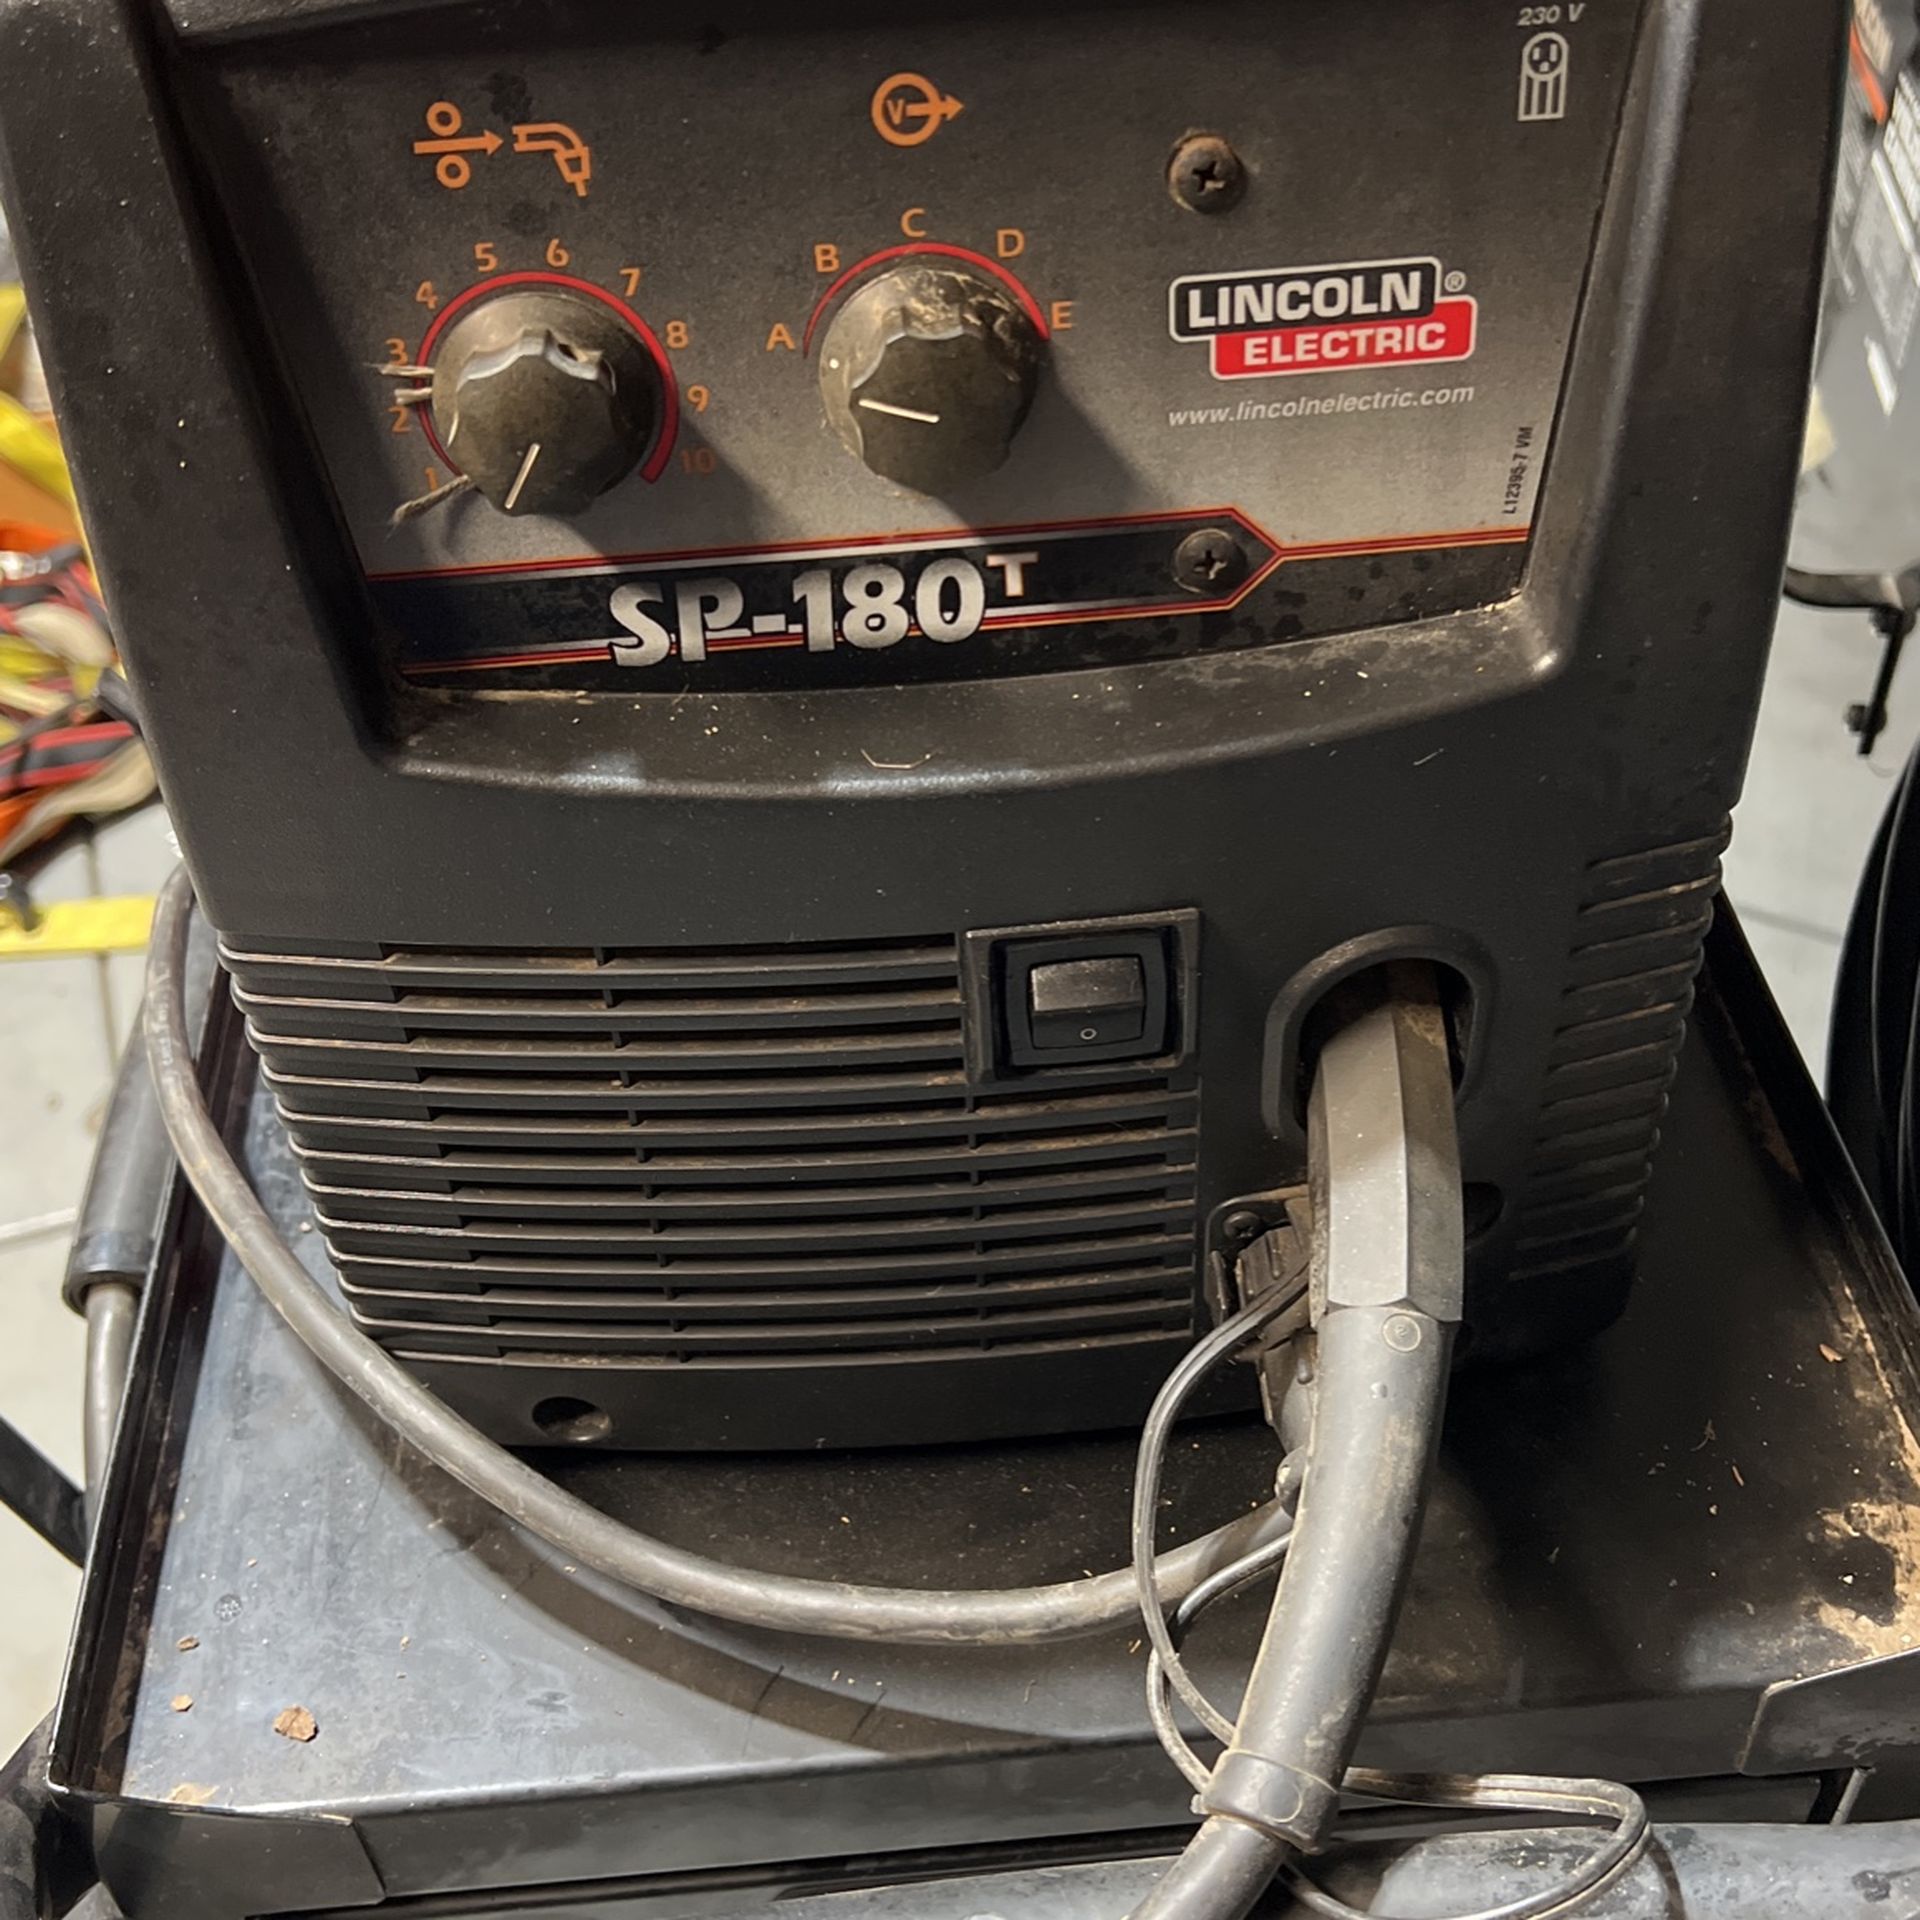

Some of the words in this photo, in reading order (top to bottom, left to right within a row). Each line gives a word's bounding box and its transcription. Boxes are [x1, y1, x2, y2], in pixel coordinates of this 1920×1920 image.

[1517, 5, 1560, 26] 230
[1568, 3, 1586, 22] V
[474, 242, 498, 272] 5
[546, 239, 570, 267] 6
[620, 267, 643, 296] 7
[766, 323, 795, 350] A
[814, 244, 841, 273] B
[901, 208, 927, 238] C
[997, 229, 1025, 258] D
[1051, 301, 1073, 330] E
[415, 281, 439, 309] 4
[1188, 270, 1422, 329] LINCOLN
[665, 320, 689, 349] 8
[1244, 322, 1447, 367] ELECTRIC
[385, 338, 409, 367] 3
[687, 384, 710, 412] 9
[1168, 386, 1475, 427] www.lincolnelectric.com
[388, 405, 411, 433] 2
[1514, 426, 1534, 449] VM
[682, 447, 716, 474] 10
[425, 467, 439, 492] 1
